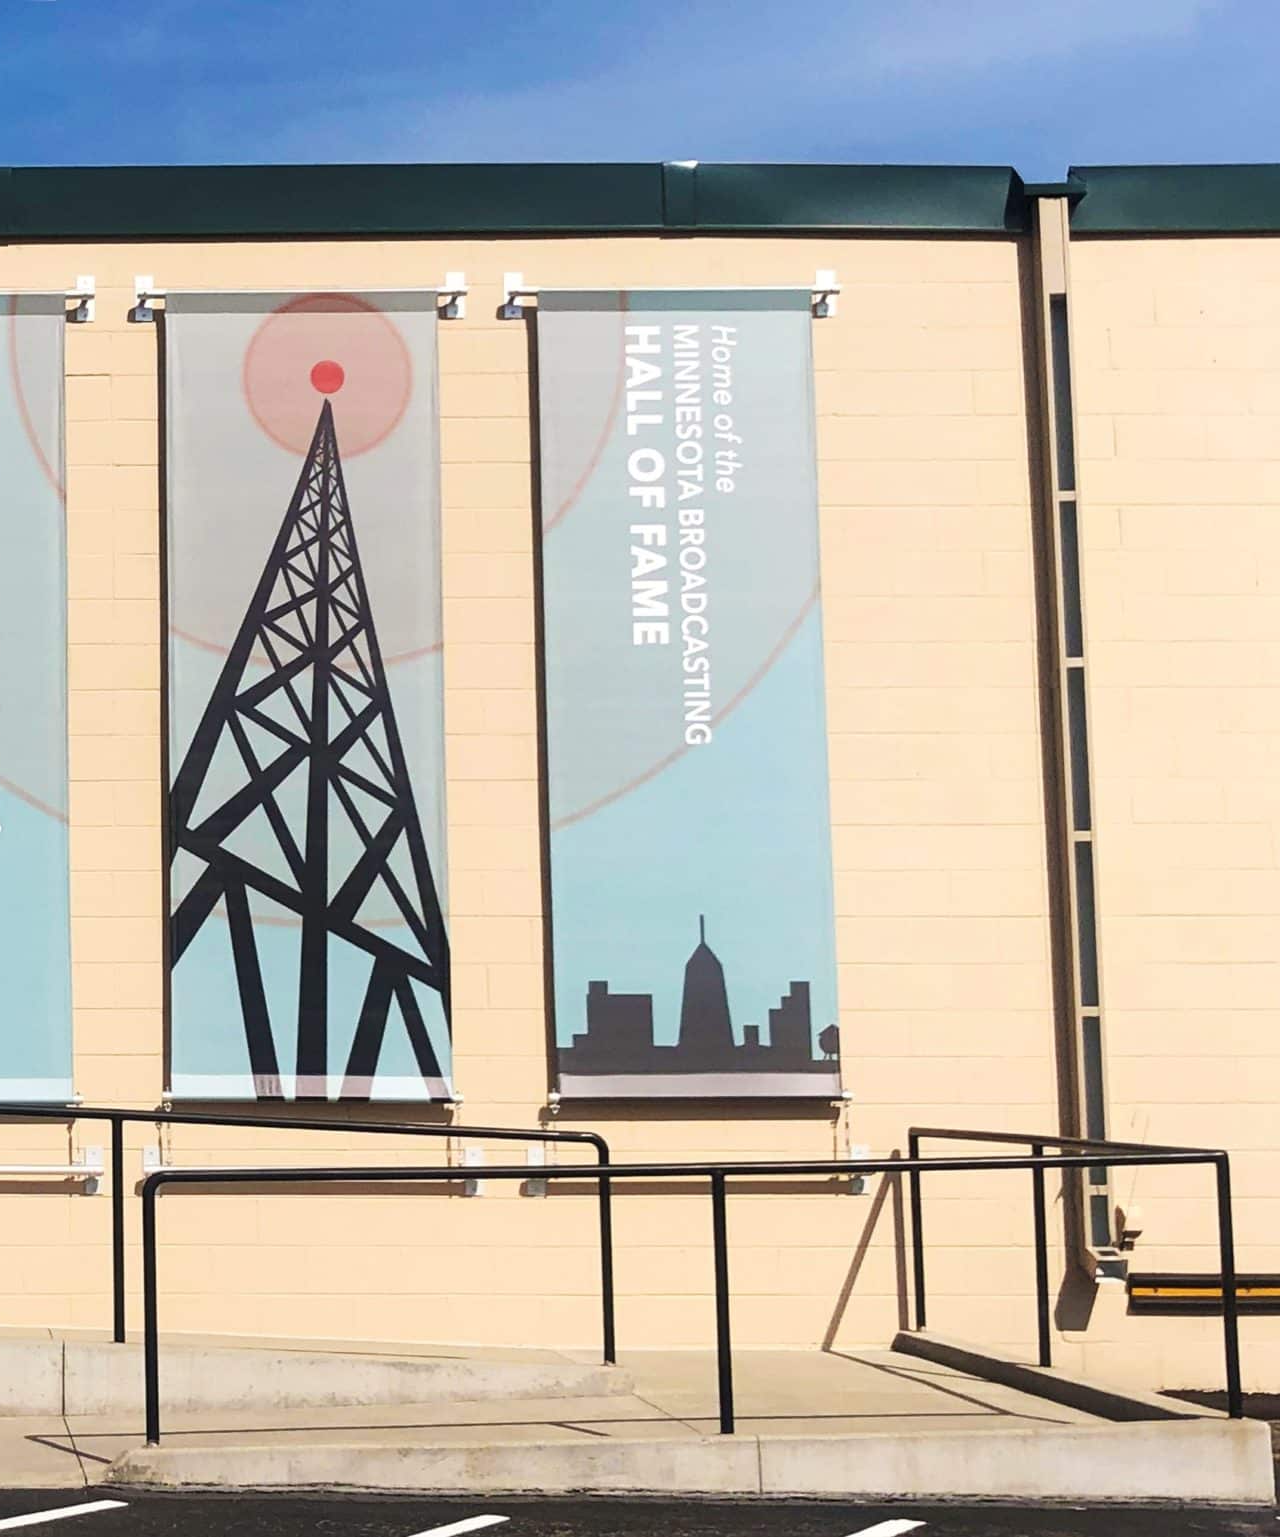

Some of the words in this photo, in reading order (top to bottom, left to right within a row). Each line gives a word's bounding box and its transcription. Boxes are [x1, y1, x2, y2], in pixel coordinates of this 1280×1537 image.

[624, 325, 664, 436] HALL
[672, 324, 705, 501] MINNESOTA
[710, 324, 739, 406] Home
[713, 413, 743, 445] of
[715, 449, 744, 494] the
[627, 447, 667, 509] OF
[629, 524, 670, 646] FAME
[678, 508, 712, 745] BROADCASTING
